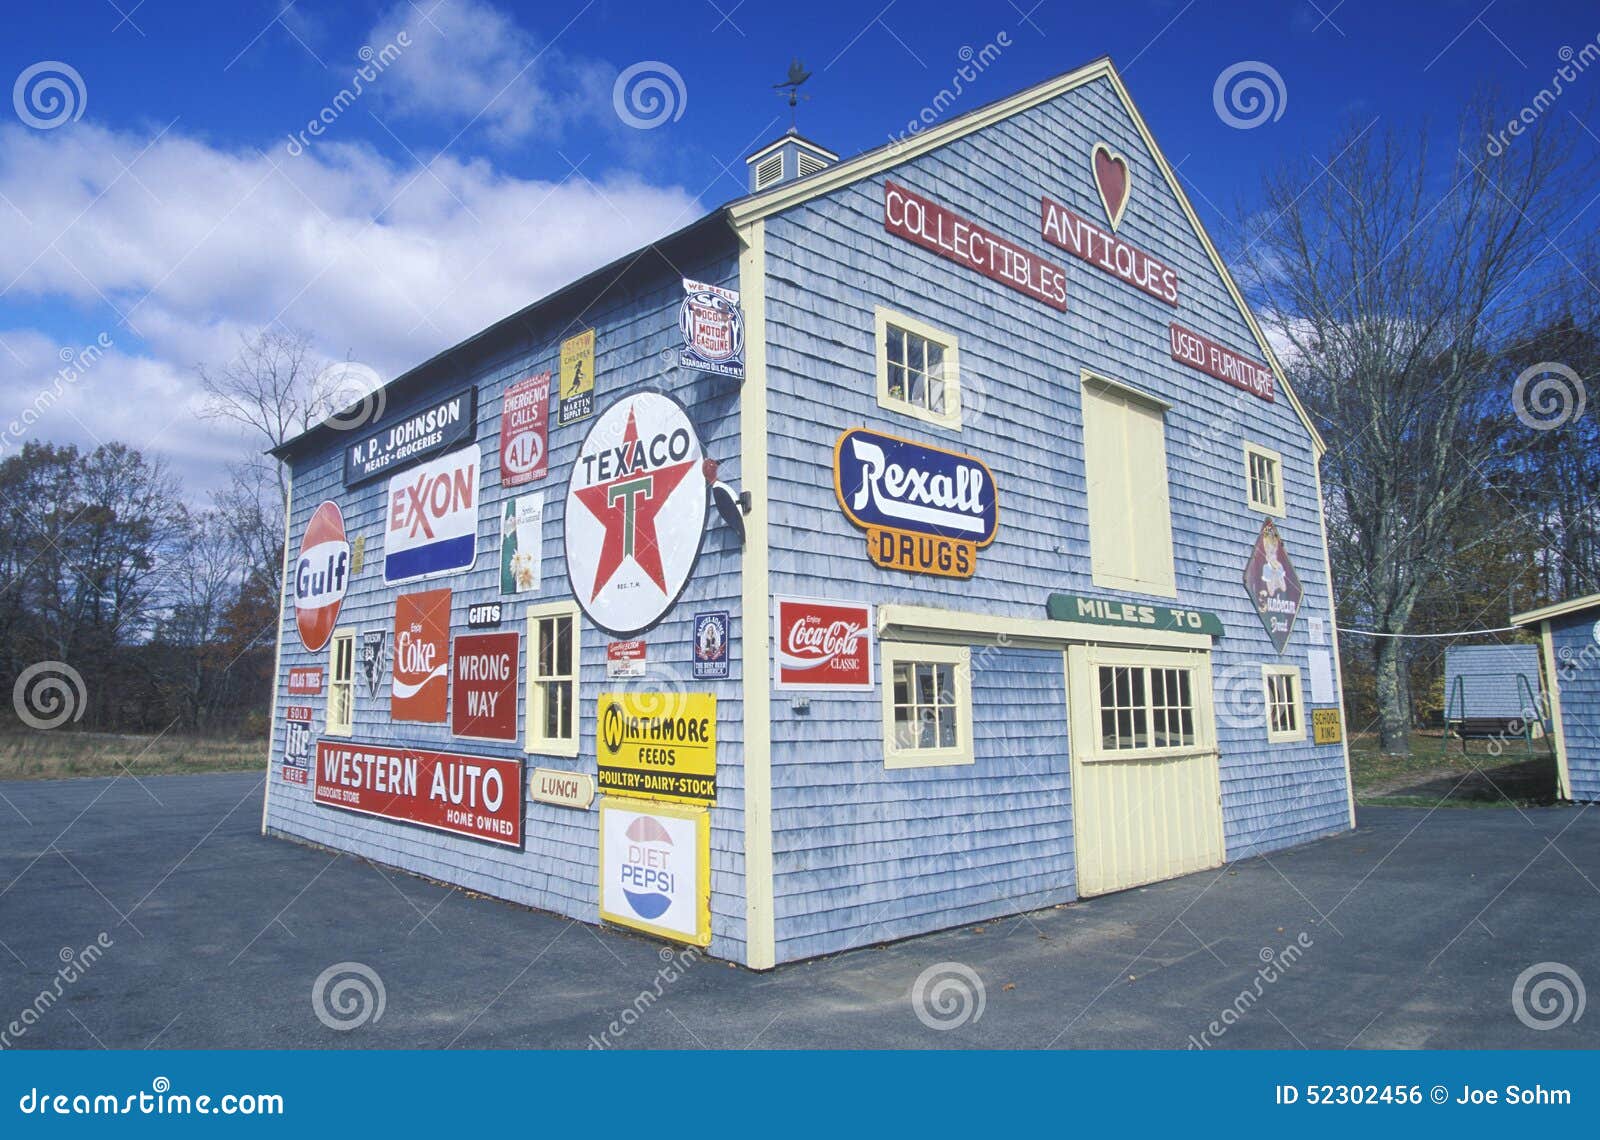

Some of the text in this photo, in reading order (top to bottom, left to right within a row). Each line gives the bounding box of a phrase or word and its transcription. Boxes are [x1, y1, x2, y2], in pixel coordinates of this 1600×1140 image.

[886, 191, 1066, 303] COLLECTIBLES
[1043, 205, 1178, 301] ANTIQUES
[696, 334, 729, 351] GASOLINE
[699, 323, 727, 339] MOTOR
[1171, 328, 1273, 397] USED FURNITURE
[504, 382, 550, 414] EMERGENCY
[563, 397, 591, 411] MARTIN
[511, 404, 538, 427] CALLS
[563, 408, 581, 421] SUPPLY
[353, 399, 460, 466] N. P. JOHNSON
[510, 437, 539, 467] ALA
[582, 427, 690, 485] TEXACO
[851, 436, 984, 517] Rexall
[389, 463, 475, 540] EXXON
[879, 531, 969, 574] DRUGS
[296, 551, 347, 598] Gulf
[469, 605, 501, 624] GIFTS
[1077, 598, 1202, 629] MILES TO
[1258, 590, 1296, 615] Sunbeam
[806, 615, 821, 624] Enjoy
[398, 631, 436, 673] Coke
[830, 658, 860, 670] CLASSIC
[290, 673, 305, 688] ATLAS
[459, 653, 510, 681] WRONG
[290, 707, 308, 720] SOLD
[467, 690, 498, 717] WAY
[605, 706, 709, 751] WIRTHMORE
[1314, 712, 1338, 725] SCHOOL
[1321, 727, 1335, 739] XING
[639, 748, 675, 766] FEEDS
[285, 768, 303, 782] HERE
[323, 749, 503, 813] WESTERN AUTO
[540, 777, 578, 799] LUNCH
[317, 785, 360, 804] ASSOCIATE STORE
[447, 809, 513, 836] HOME OWNED
[628, 847, 671, 869] DIET
[621, 864, 675, 894] PEPSI
